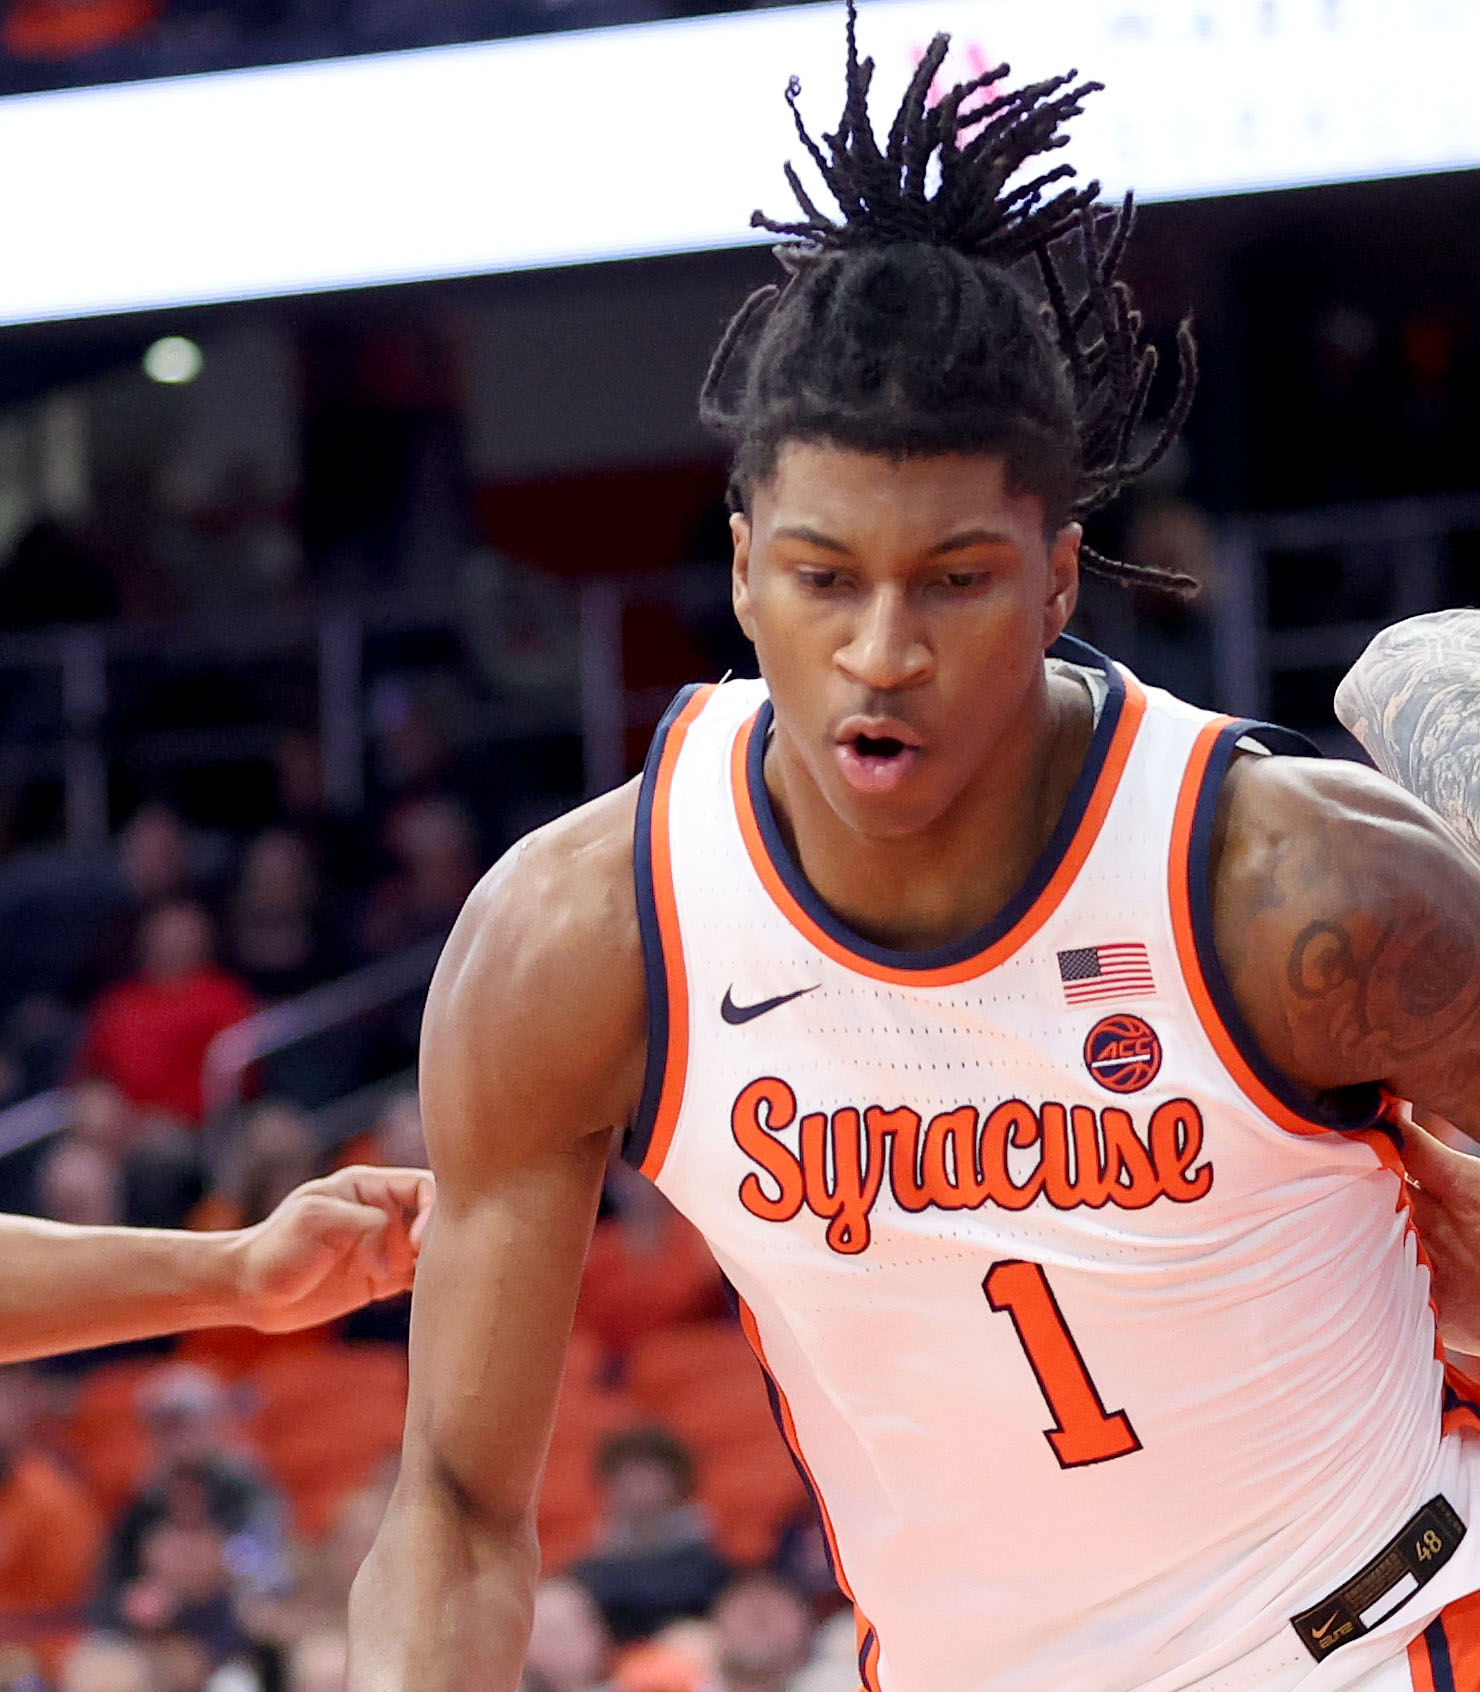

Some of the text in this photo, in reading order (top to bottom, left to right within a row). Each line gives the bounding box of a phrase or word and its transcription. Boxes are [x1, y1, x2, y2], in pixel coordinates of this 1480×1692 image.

[1096, 1037, 1153, 1060] ACC
[730, 1076, 1214, 1254] Syracuse
[981, 1258, 1143, 1470] 1
[1414, 1529, 1444, 1563] 48
